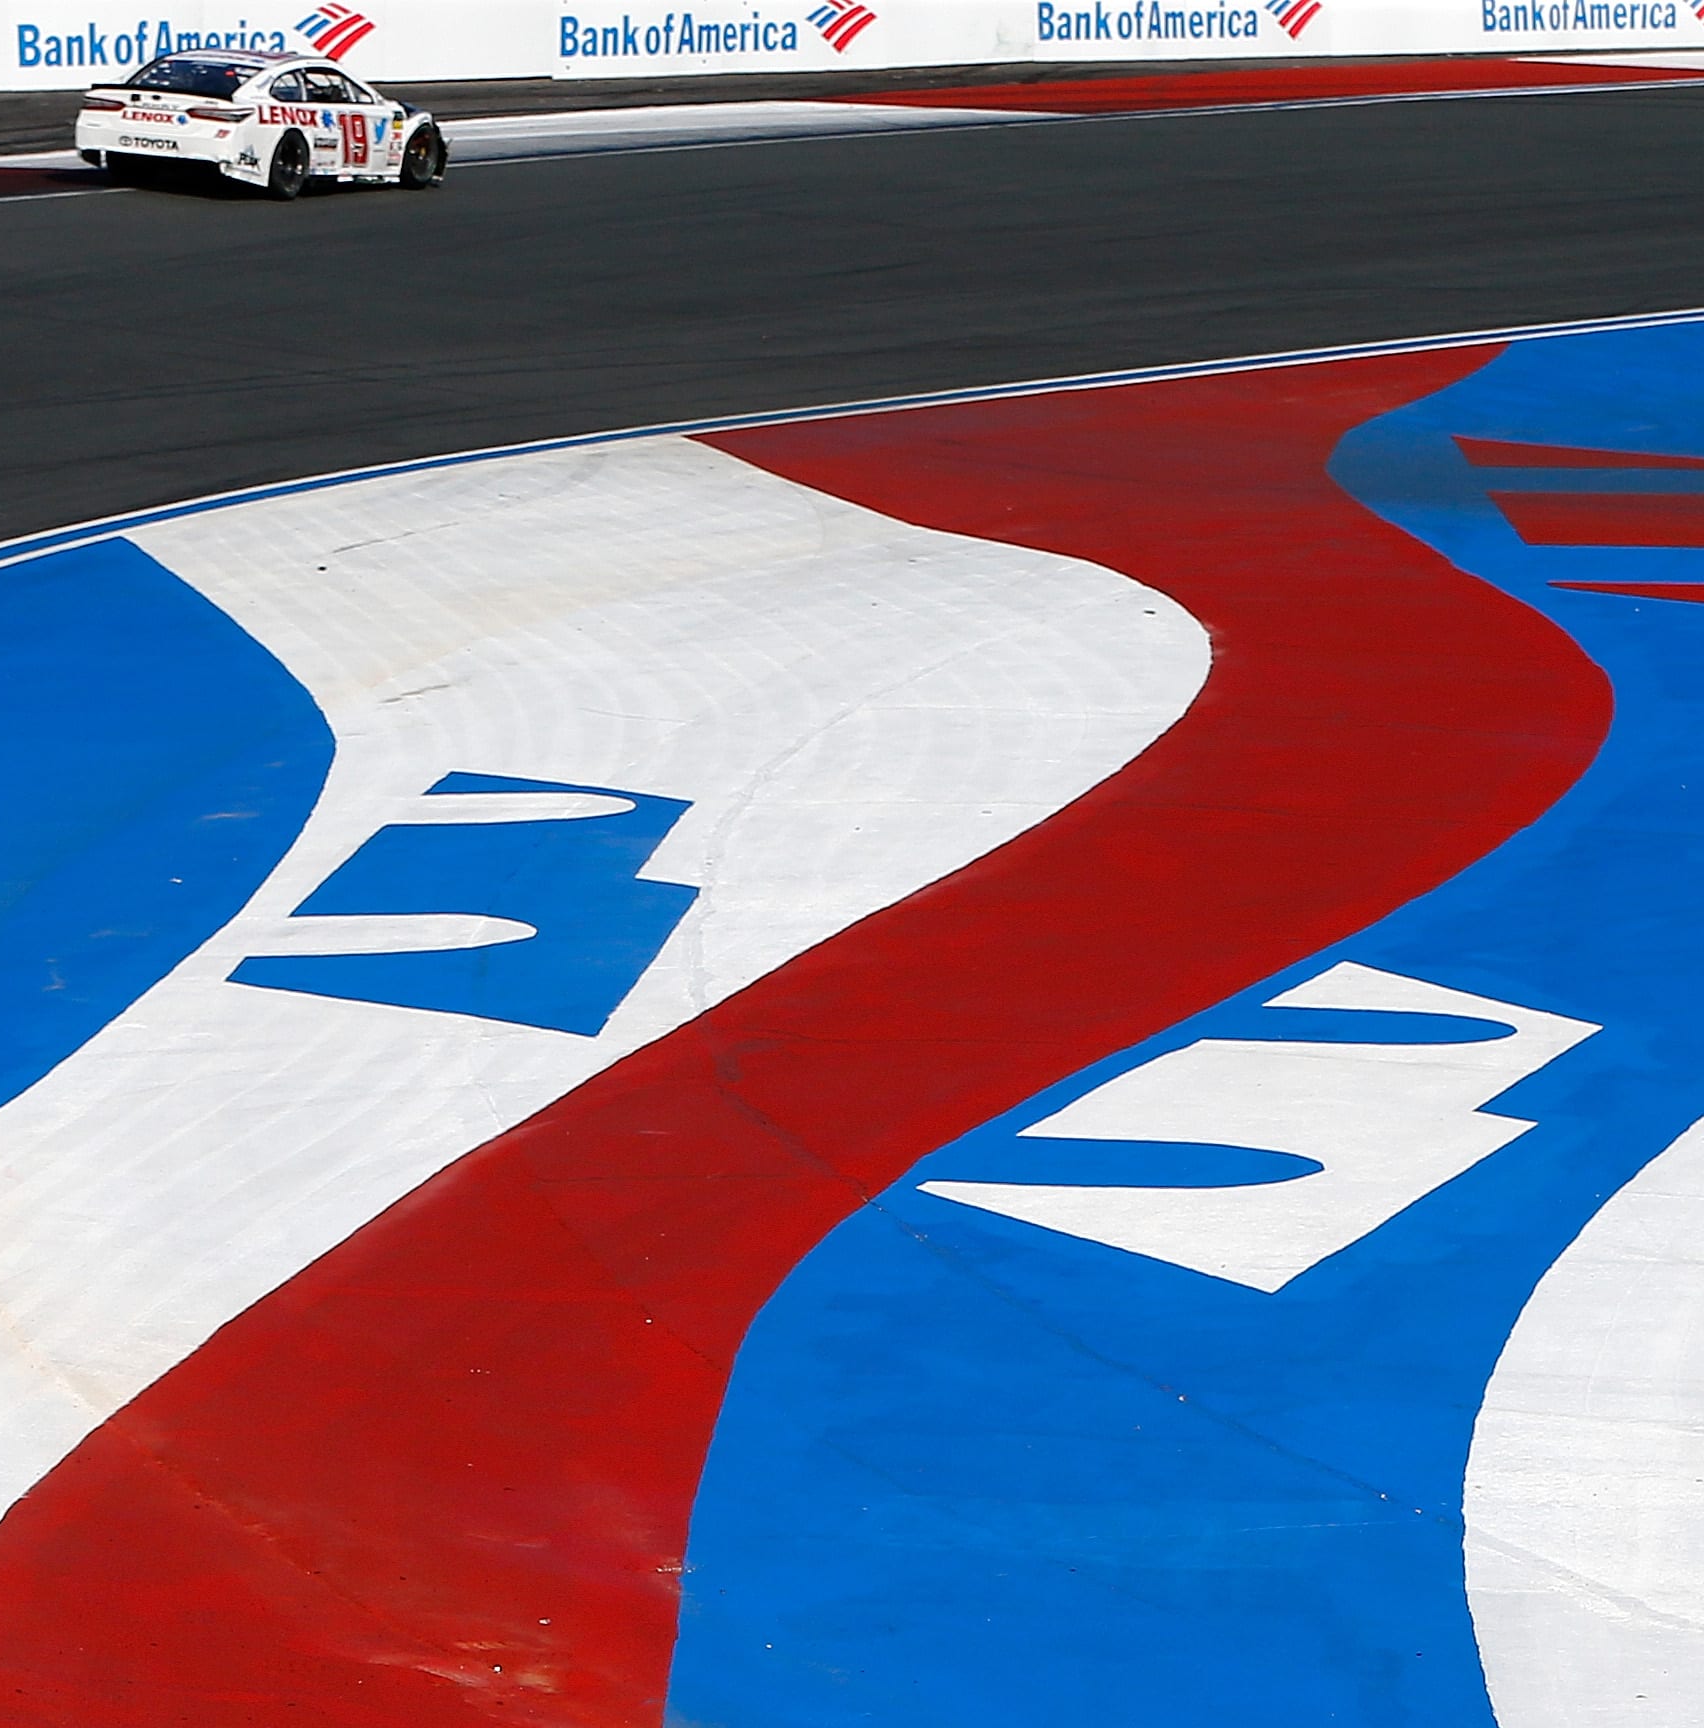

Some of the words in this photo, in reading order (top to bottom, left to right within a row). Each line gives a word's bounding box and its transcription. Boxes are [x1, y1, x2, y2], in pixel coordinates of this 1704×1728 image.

[1038, 1, 1112, 40] Bank
[1117, 0, 1144, 39] of
[1148, 0, 1257, 38] America
[1483, 0, 1545, 31] Bank
[1573, 0, 1676, 30] America
[18, 23, 109, 67] Bank
[114, 20, 148, 65] of
[155, 20, 285, 59] America
[560, 15, 639, 57] Bank
[646, 13, 674, 55] of
[678, 11, 797, 54] America
[122, 110, 174, 124] LENOX
[258, 105, 317, 127] LENOX
[134, 137, 179, 150] TOYOTA
[338, 112, 369, 165] 19
